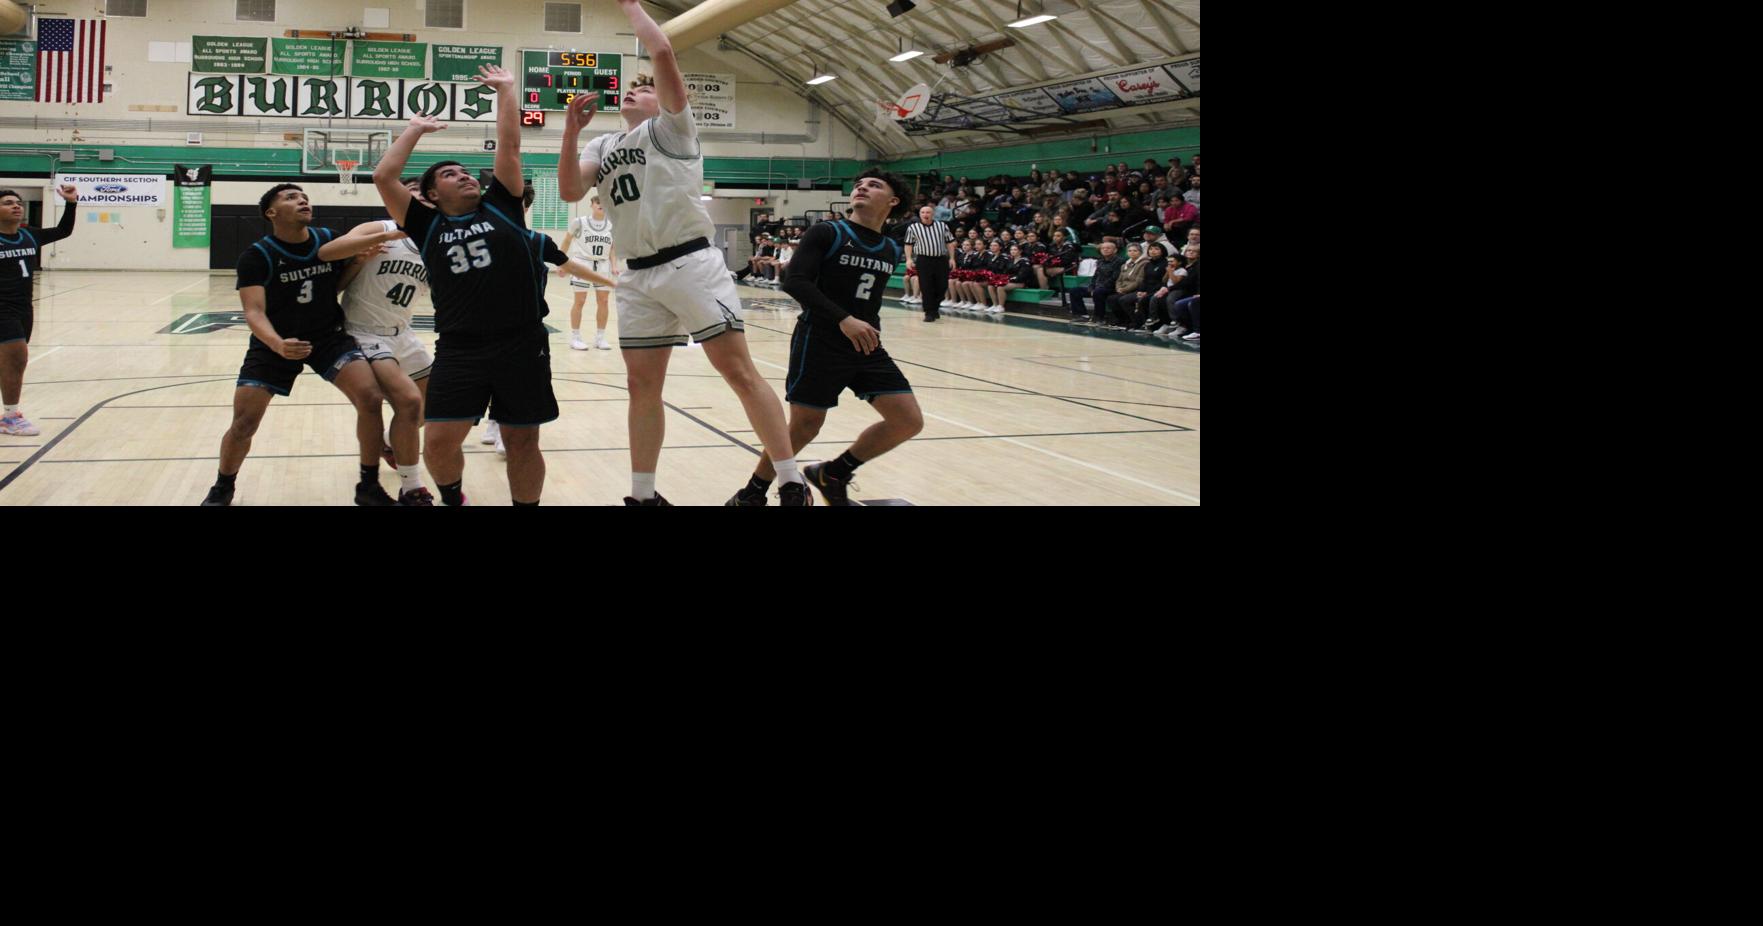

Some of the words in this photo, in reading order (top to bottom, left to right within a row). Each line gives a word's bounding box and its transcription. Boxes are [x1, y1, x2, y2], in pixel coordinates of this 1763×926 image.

[438, 46, 466, 54] GOLDEN
[560, 53, 596, 66] 5:56
[528, 66, 550, 74] HOME
[593, 68, 618, 76] GUEST
[543, 74, 553, 88] 7
[572, 77, 577, 87] 1
[609, 76, 618, 90] 3
[704, 84, 720, 92] 03
[194, 76, 497, 120] BURROS
[530, 92, 539, 103] 0
[613, 95, 618, 105] 1
[523, 111, 543, 125] 29
[704, 112, 720, 120] 03
[76, 195, 158, 203] AMPIONSHIPS
[446, 239, 492, 274] 35
[592, 245, 604, 256] 10
[19, 259, 29, 277] 1
[280, 262, 333, 283] SULTANA
[376, 260, 431, 285] BURRO
[296, 280, 313, 304] 3
[855, 272, 876, 300] 2
[386, 282, 416, 308] 40
